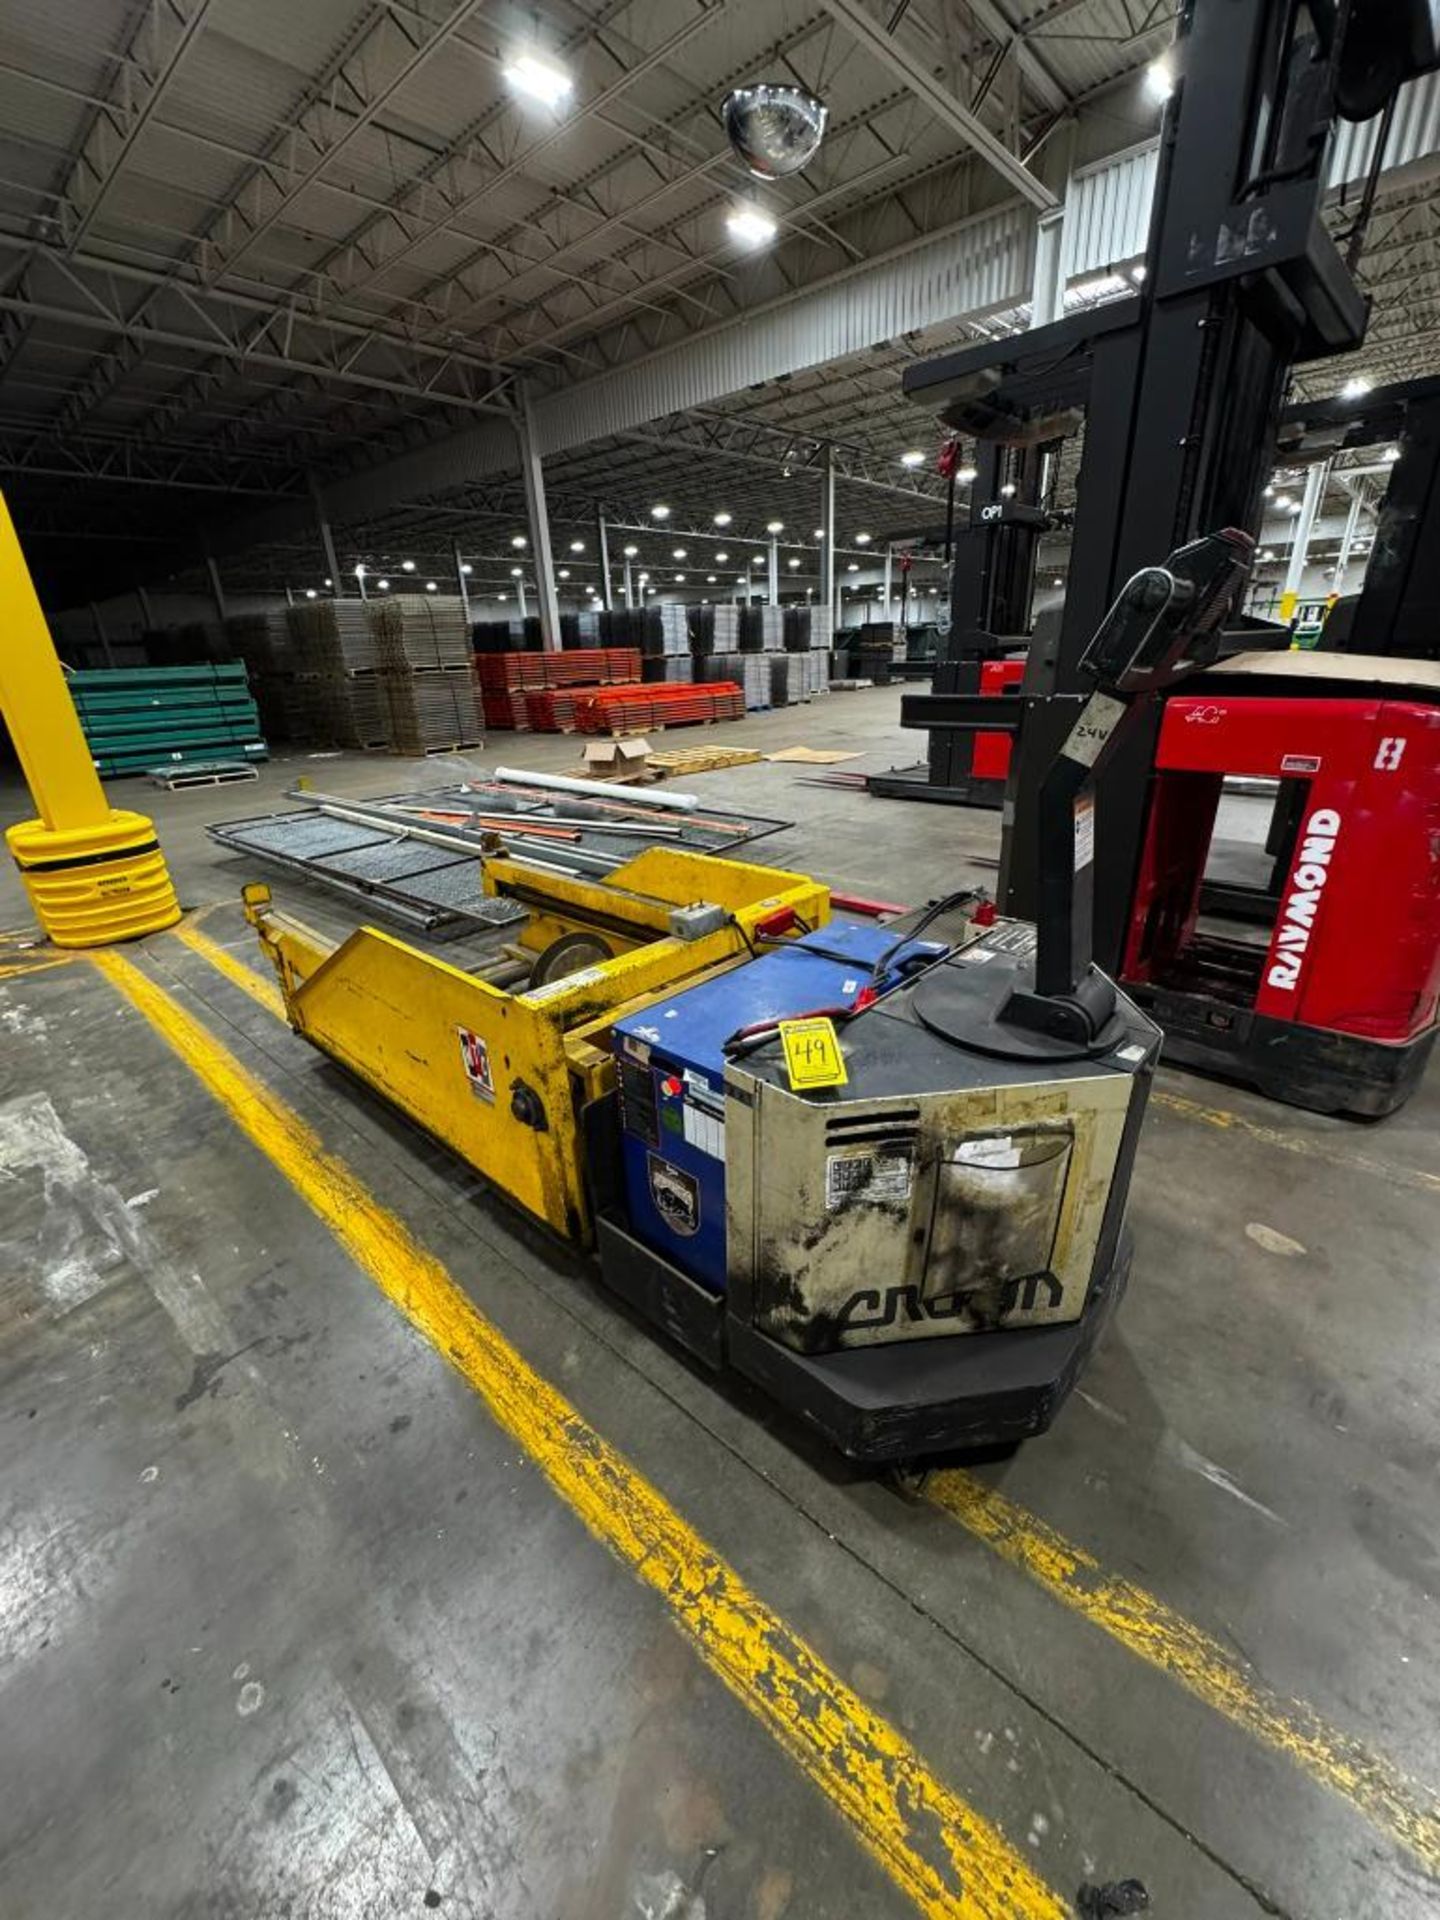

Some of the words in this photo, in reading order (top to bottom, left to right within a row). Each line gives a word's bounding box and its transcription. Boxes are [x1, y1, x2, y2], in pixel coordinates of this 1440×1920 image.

[1076, 726, 1108, 741] 24V
[1267, 808, 1342, 991] RAYMOND
[795, 1039, 826, 1065] 49
